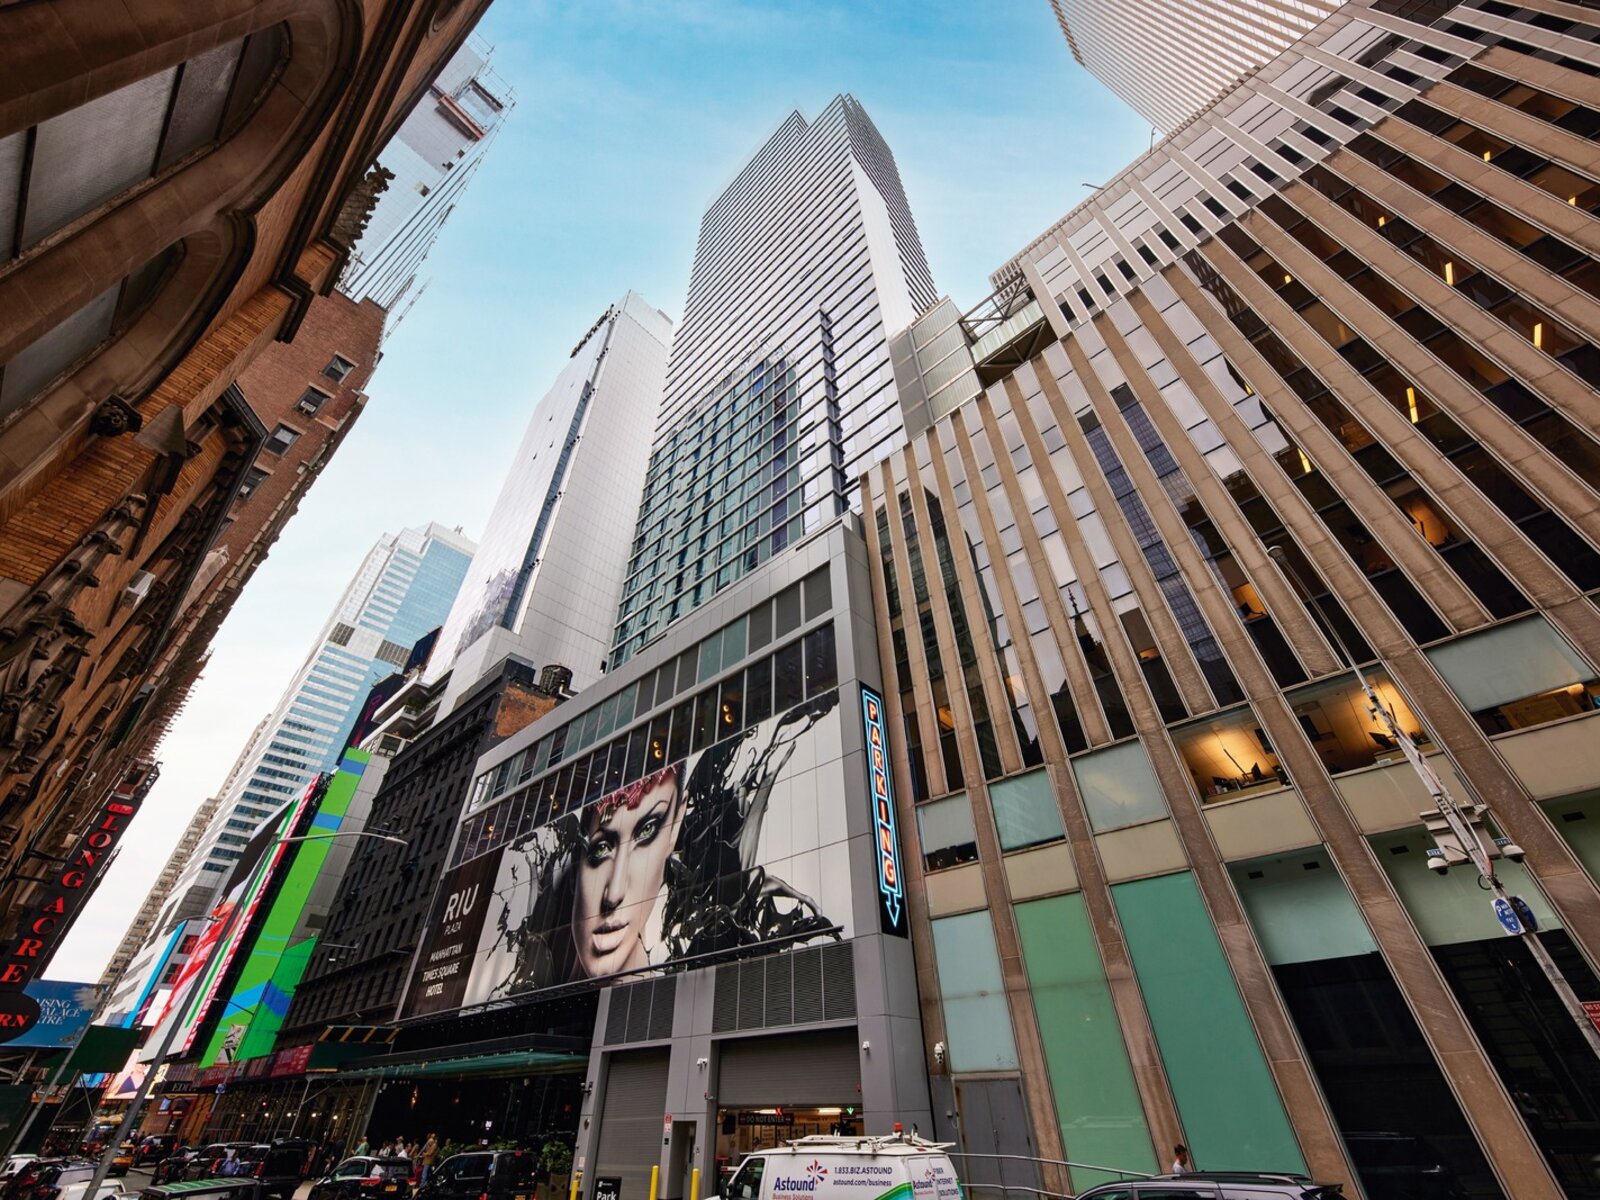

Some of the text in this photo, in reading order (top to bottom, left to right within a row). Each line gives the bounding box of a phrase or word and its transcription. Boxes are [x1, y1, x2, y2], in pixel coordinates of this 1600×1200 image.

[868, 702, 895, 884] PARKING
[61, 815, 118, 888] LONG
[442, 883, 479, 923] RIU
[444, 922, 461, 936] PLAZA
[0, 896, 65, 984] ACRE
[430, 943, 463, 962] MANHATTAN
[423, 962, 460, 982] TIMES SQUARE
[425, 982, 444, 997] HOTEL
[767, 1115, 784, 1123] ENTER
[834, 1166, 892, 1175] 1.833.BIZ.ASTOUND
[774, 1176, 815, 1191] Astound
[833, 1178, 892, 1187] astound.com/business
[596, 1191, 617, 1200] Park
